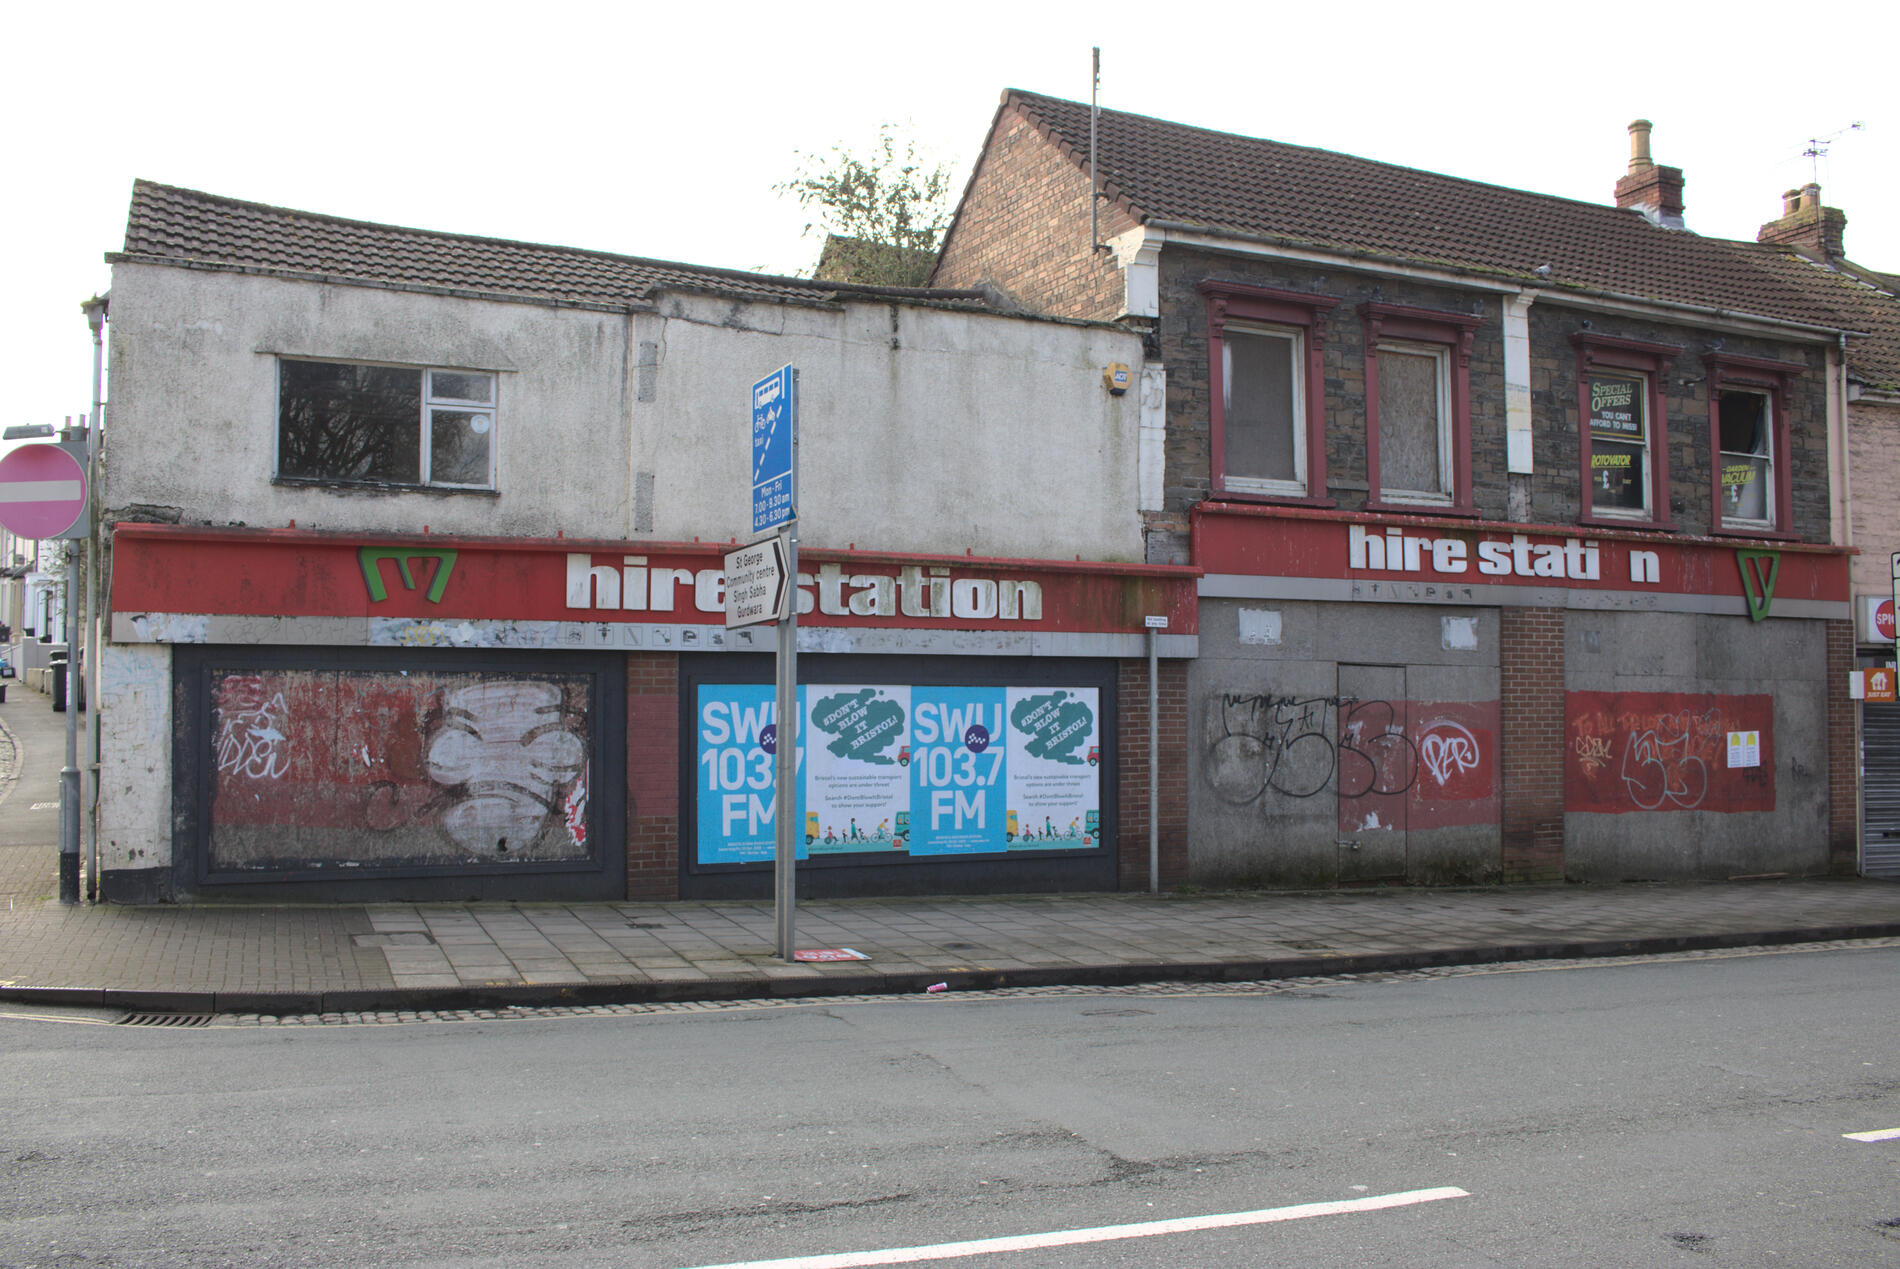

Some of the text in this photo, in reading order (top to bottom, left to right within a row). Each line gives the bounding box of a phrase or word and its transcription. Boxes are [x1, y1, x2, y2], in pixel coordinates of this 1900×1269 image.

[1592, 382, 1633, 397] SPECIAL
[1591, 394, 1632, 411] OFFERS
[1602, 411, 1614, 420] YOU
[1612, 421, 1621, 430] TO
[1591, 454, 1632, 468] ROTOVATOR
[761, 486, 772, 498] Mon
[775, 480, 783, 492] Fri
[1349, 524, 1468, 574] hire
[736, 552, 763, 569] St George
[727, 565, 775, 588] Community centre
[733, 584, 766, 603] Singh Sabha
[737, 603, 763, 618] Gurdwara
[823, 698, 859, 727] #DON'T
[837, 706, 868, 731] BLOW
[913, 702, 1003, 743] SWU
[1034, 707, 1061, 732] BLOW
[849, 714, 899, 750] BRISTOL!
[854, 720, 868, 734] IT
[1045, 716, 1088, 751] BRISTOL!
[1048, 722, 1061, 734] IT
[913, 746, 1005, 787] 103.7
[722, 793, 777, 836] FM
[931, 789, 986, 830] FM
